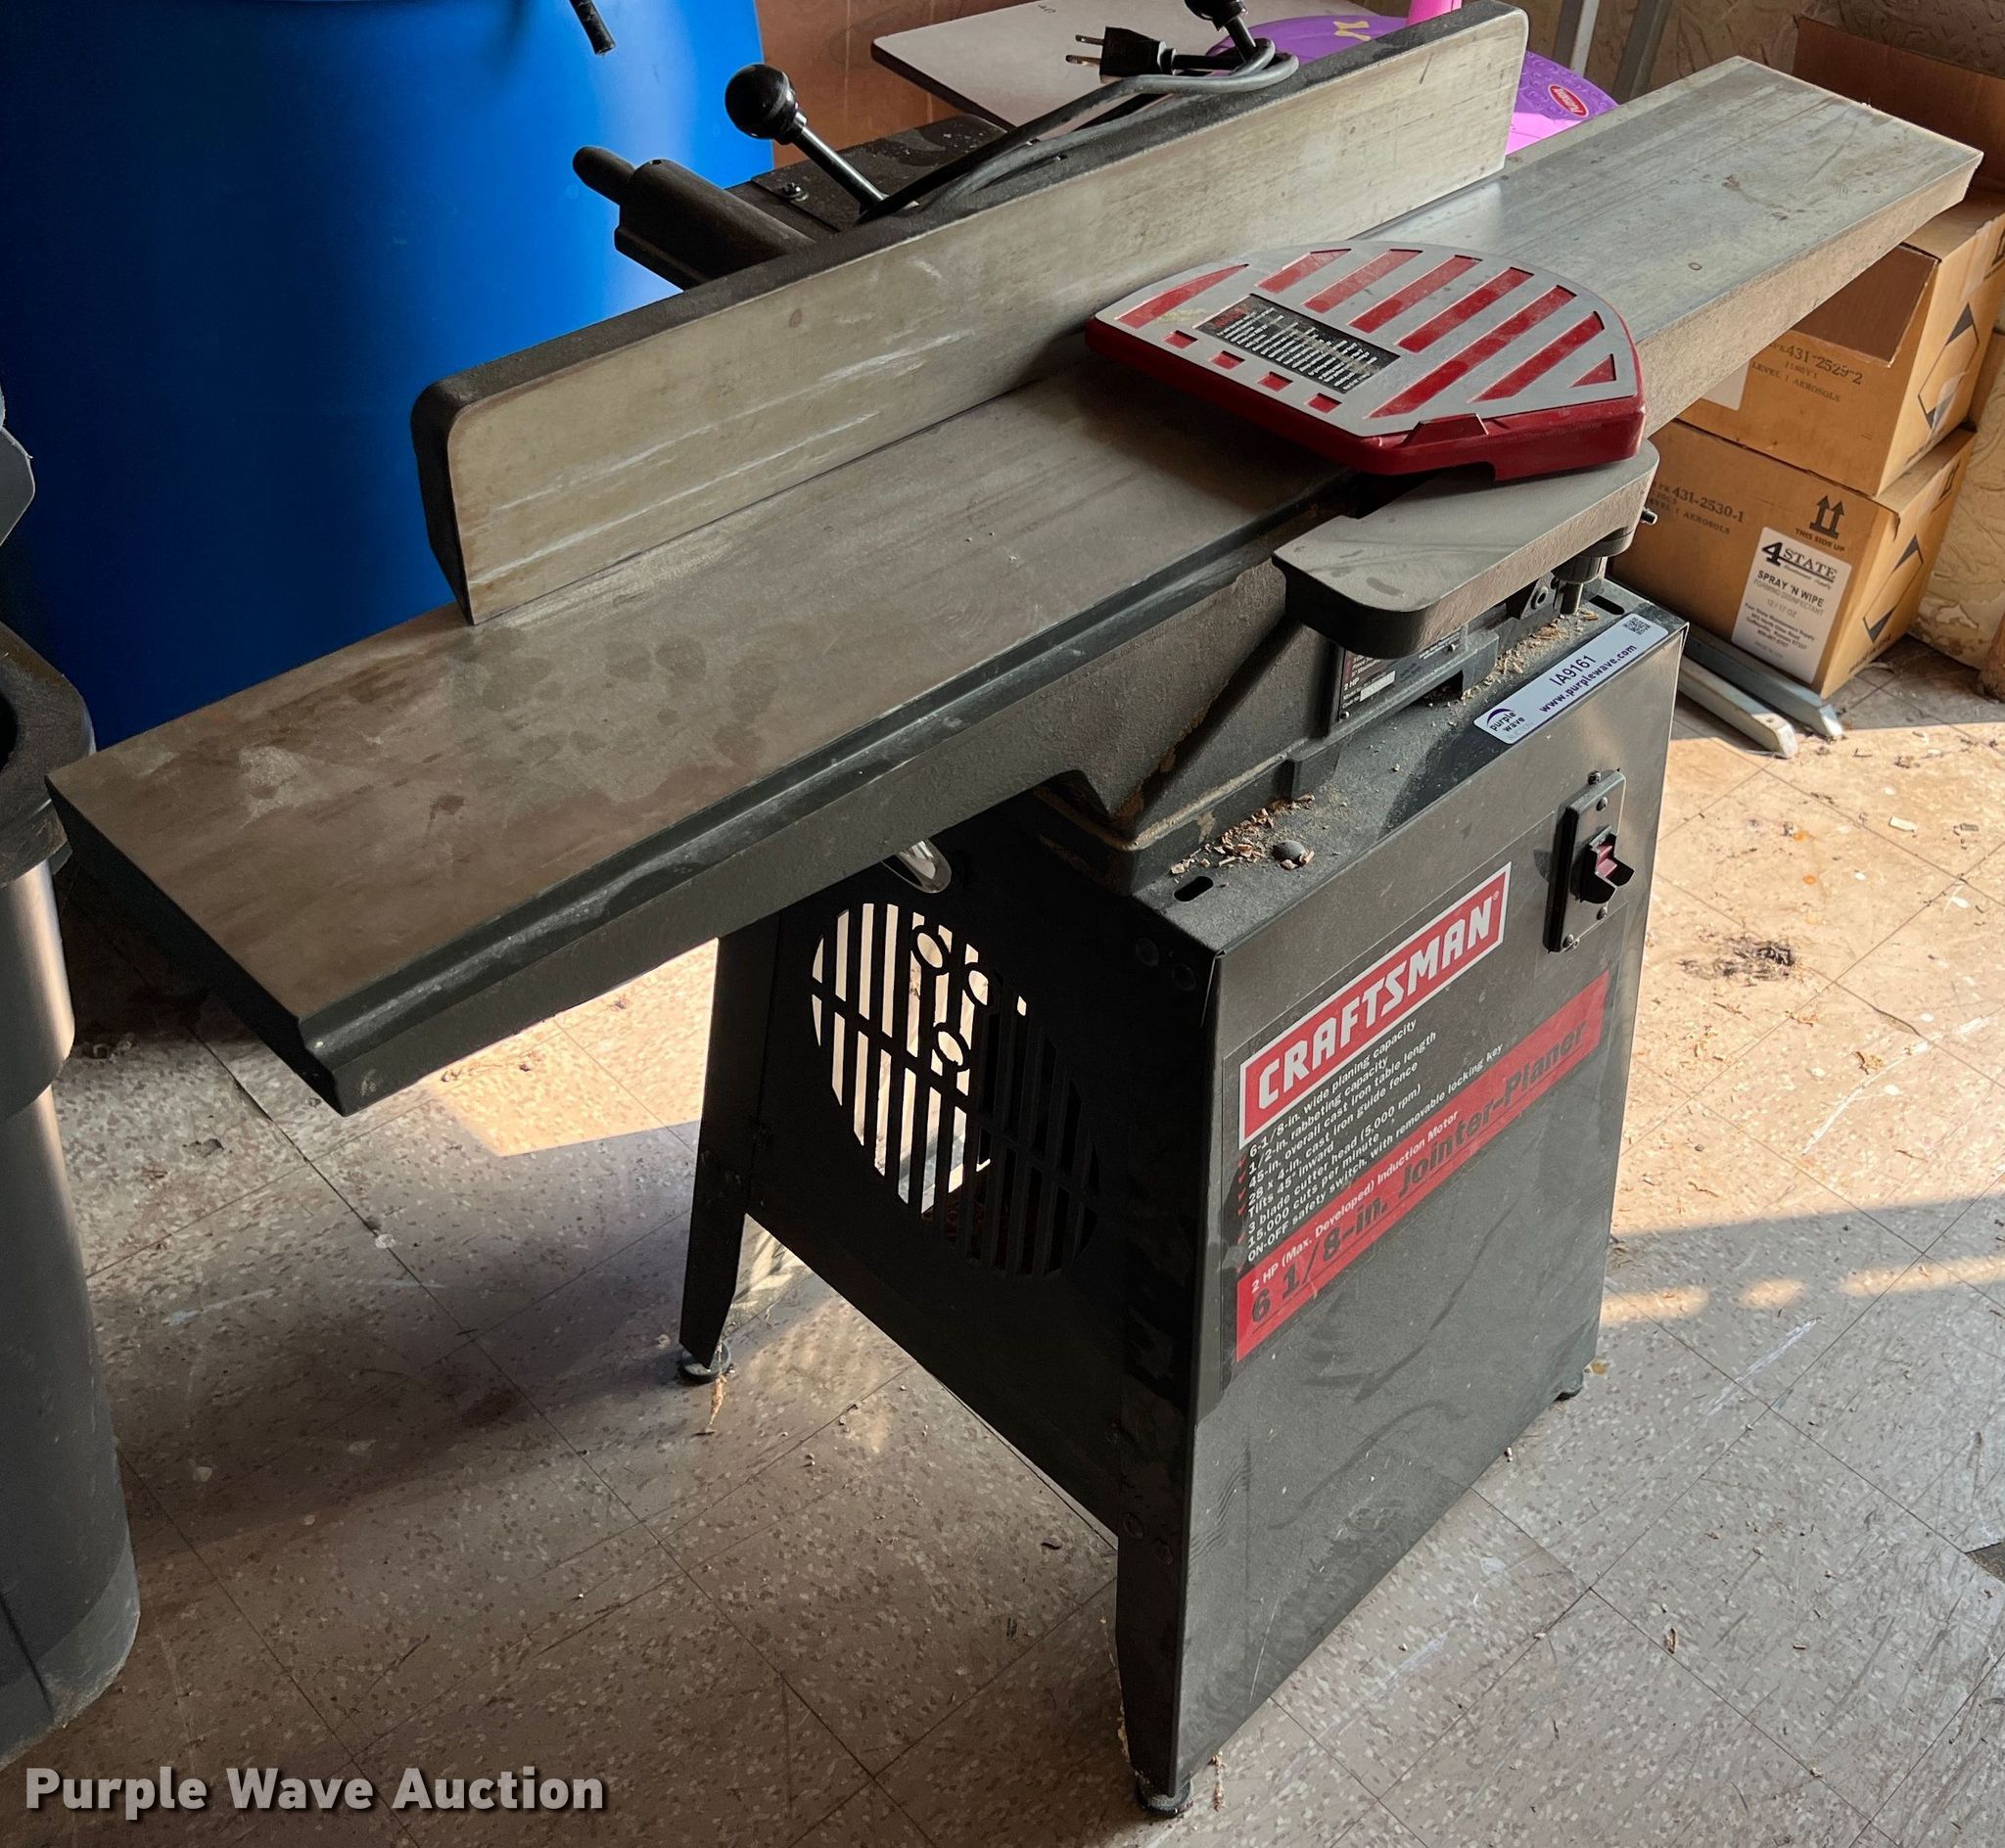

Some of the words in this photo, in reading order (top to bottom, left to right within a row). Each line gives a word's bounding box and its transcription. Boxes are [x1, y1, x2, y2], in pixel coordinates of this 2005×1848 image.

[1751, 361, 1780, 378] LEVEL
[1672, 486, 1745, 524] 431-2530-1
[1795, 528, 1813, 540] THIS
[1814, 535, 1832, 547] SIDE
[1757, 570, 1789, 590] SPRAY
[1800, 588, 1825, 607] WIPE
[1783, 548, 1838, 580] STATE
[1539, 643, 1637, 714] www.purplewave.com
[1549, 654, 1597, 686] IA9161
[1489, 711, 1515, 732] purple
[1503, 716, 1526, 732] wave
[1259, 898, 1495, 1111] CRAFTSMAN
[1248, 1186, 1264, 1206] 28
[1277, 1158, 1302, 1180] 4-in.
[1305, 1132, 1329, 1158] cast
[1333, 1114, 1354, 1135] iron
[1357, 1087, 1386, 1119] guide
[1389, 1062, 1419, 1089] fence
[1249, 1114, 1301, 1158] 6-1/8-in.
[1303, 1088, 1329, 1114] wide
[1331, 1054, 1371, 1094] planing
[1373, 1019, 1417, 1059] capacity
[1249, 1160, 1282, 1188] 45-in.
[1284, 1123, 1321, 1160] overall
[1324, 1102, 1348, 1128] cast
[1351, 1084, 1372, 1106] iron
[1375, 1060, 1401, 1086] table
[1404, 1032, 1436, 1063] length
[1249, 1138, 1288, 1175] 1/2-in.
[1291, 1092, 1342, 1140] rabbeting
[1344, 1056, 1388, 1096] capacity
[1248, 1221, 1289, 1262] ON-OFF
[1292, 1190, 1327, 1225] safety
[1371, 1134, 1393, 1159] with
[1395, 1091, 1446, 1138] removable
[1448, 1058, 1484, 1094] locking
[1486, 1042, 1504, 1062] key
[1248, 1221, 1256, 1234] 3
[1259, 1194, 1290, 1225] blade
[1294, 1162, 1329, 1195] cutter
[1331, 1135, 1358, 1165] head
[1360, 1106, 1395, 1142] (5,000
[1397, 1083, 1422, 1110] rpm)
[1248, 1193, 1274, 1219] Tilts
[1298, 1140, 1334, 1178] inward
[1248, 1207, 1289, 1249] 15,000
[1293, 1184, 1318, 1210] cuts
[1322, 1166, 1340, 1188] per
[1342, 1132, 1379, 1169] minute
[1251, 1288, 1271, 1323] 6
[1282, 1196, 1390, 1300] 1/8-in.
[1398, 1022, 1588, 1200] Jointer-Planer
[1251, 1277, 1260, 1293] 2
[1262, 1262, 1279, 1285] HP
[1282, 1237, 1313, 1268] (Max.
[1315, 1178, 1376, 1238] Developed)
[1377, 1138, 1425, 1184] Induction
[1427, 1110, 1459, 1143] Motor
